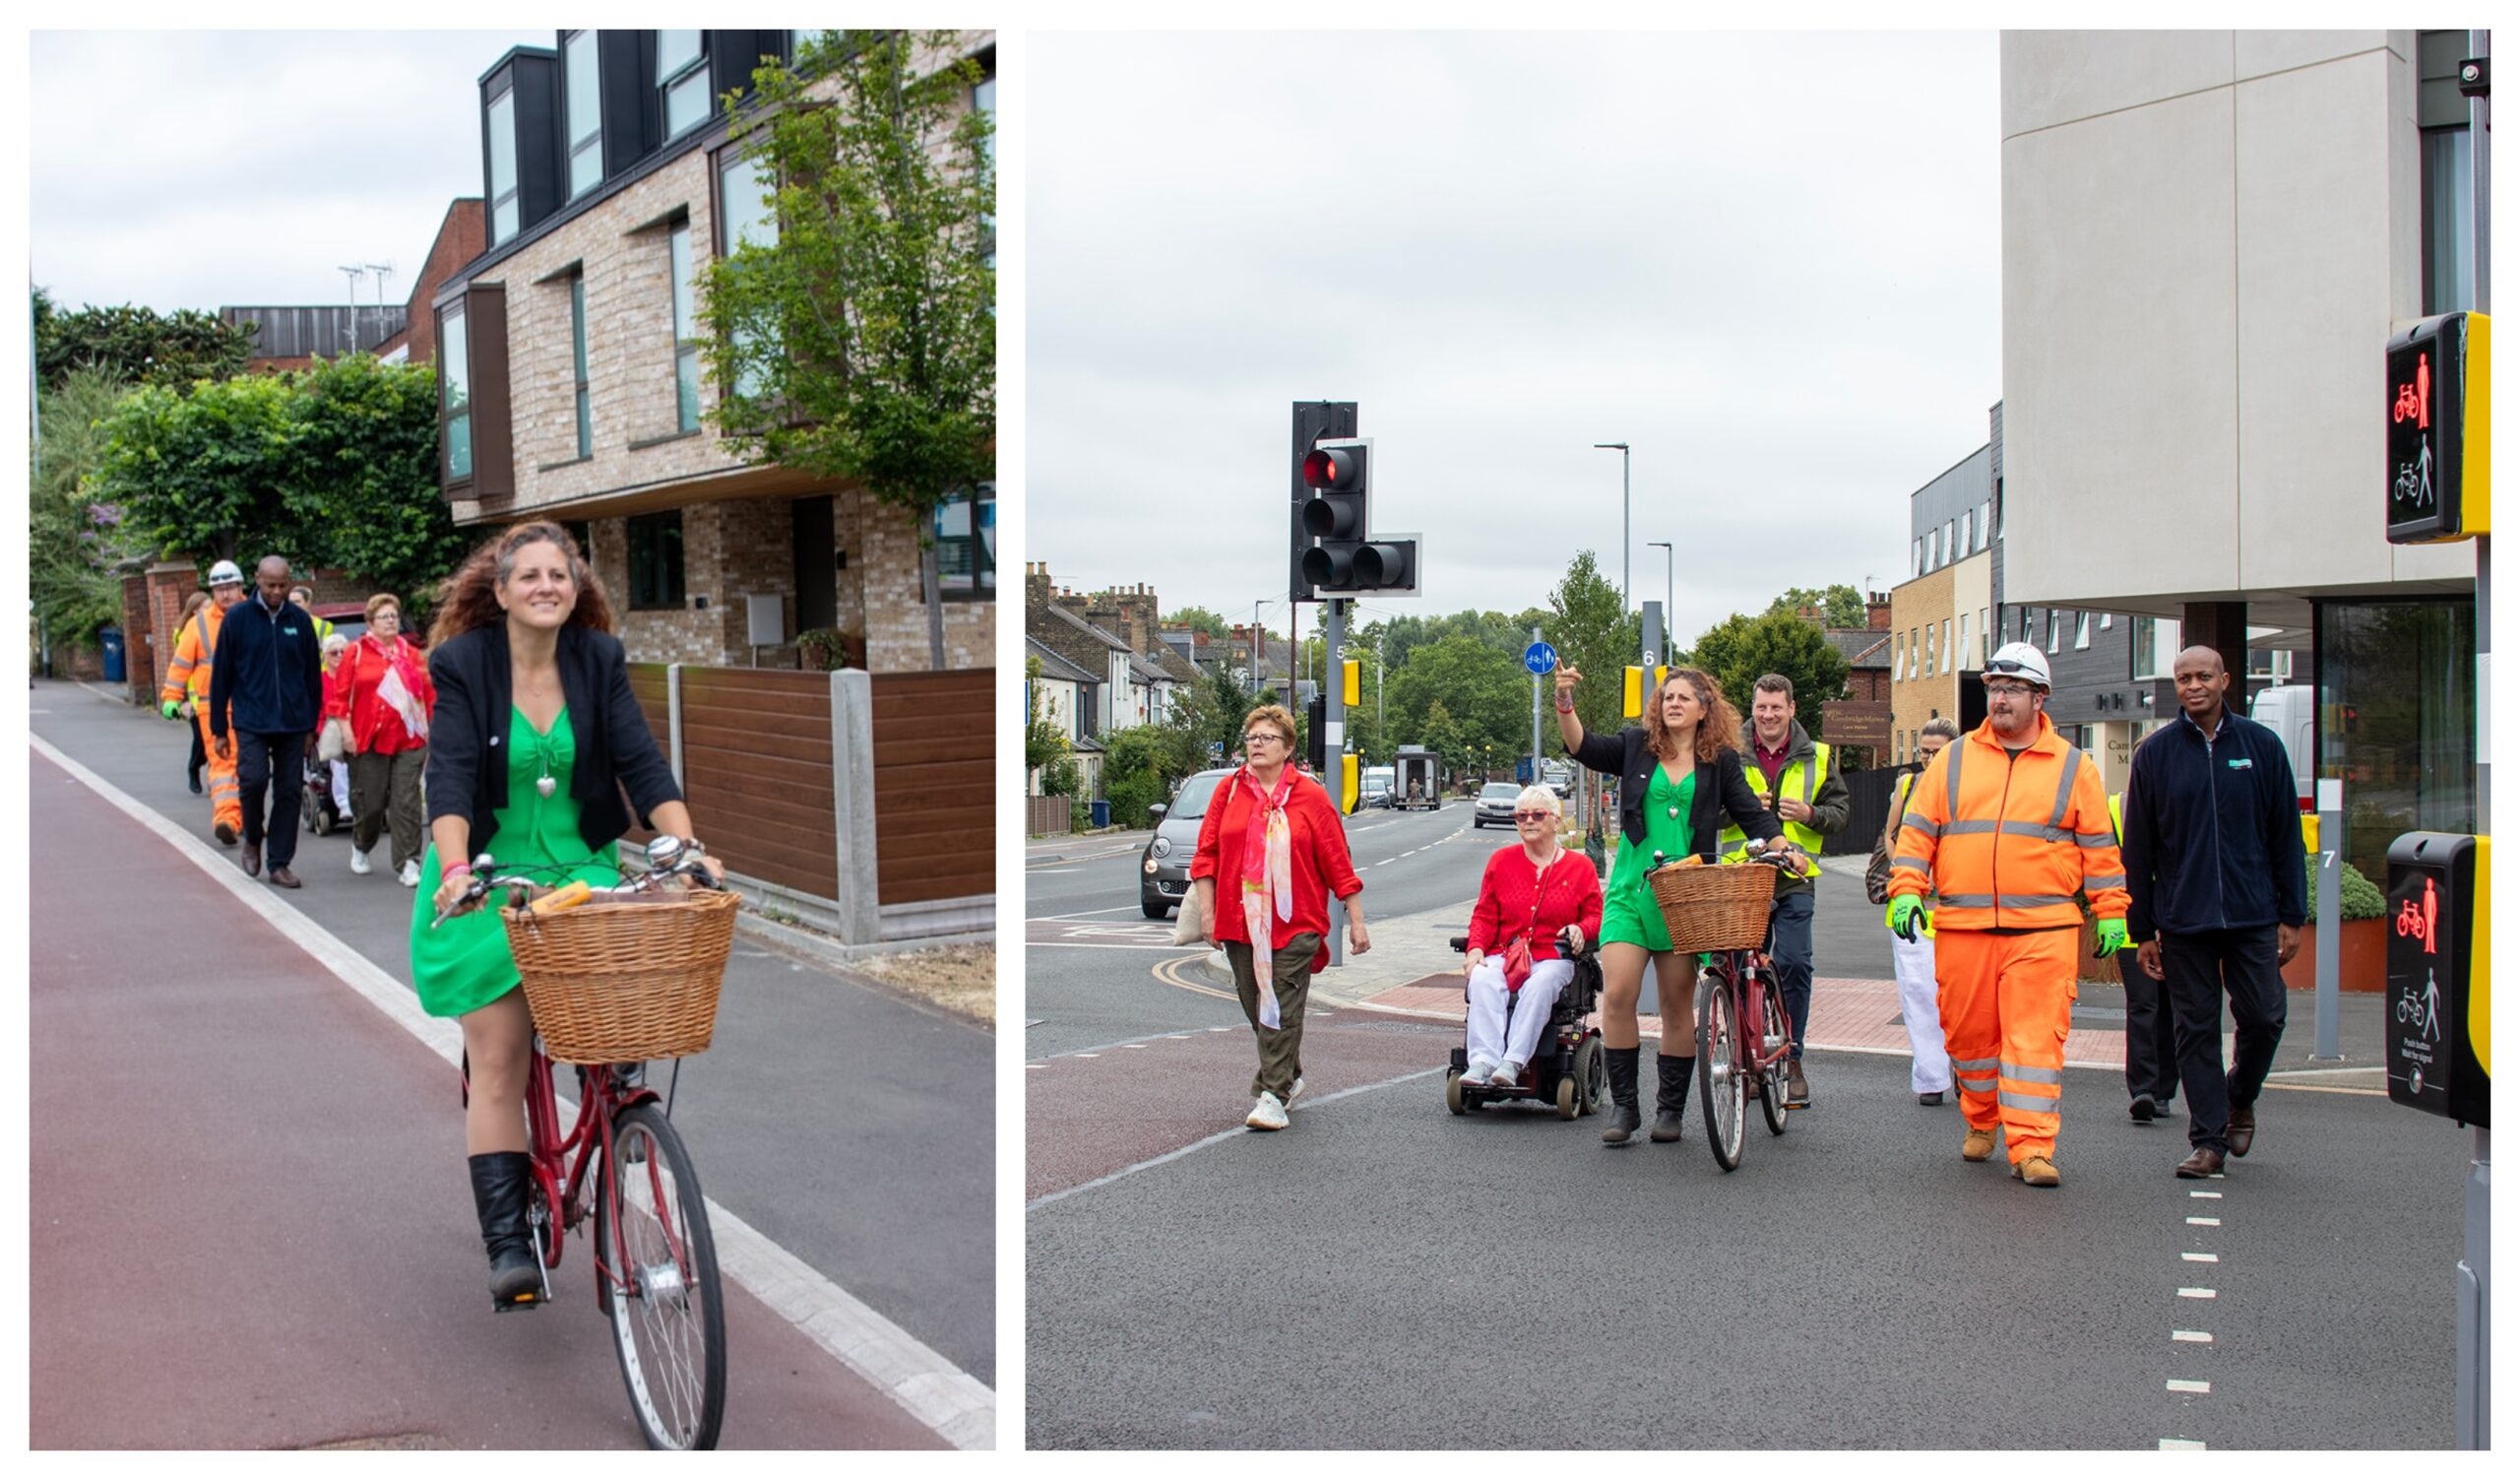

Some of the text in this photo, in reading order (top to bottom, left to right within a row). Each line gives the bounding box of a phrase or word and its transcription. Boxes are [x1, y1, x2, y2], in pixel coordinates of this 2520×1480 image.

[1337, 645, 1345, 660] 5
[1644, 650, 1655, 666] 6
[2322, 850, 2336, 869] 7
[2404, 1037, 2430, 1051] Push button
